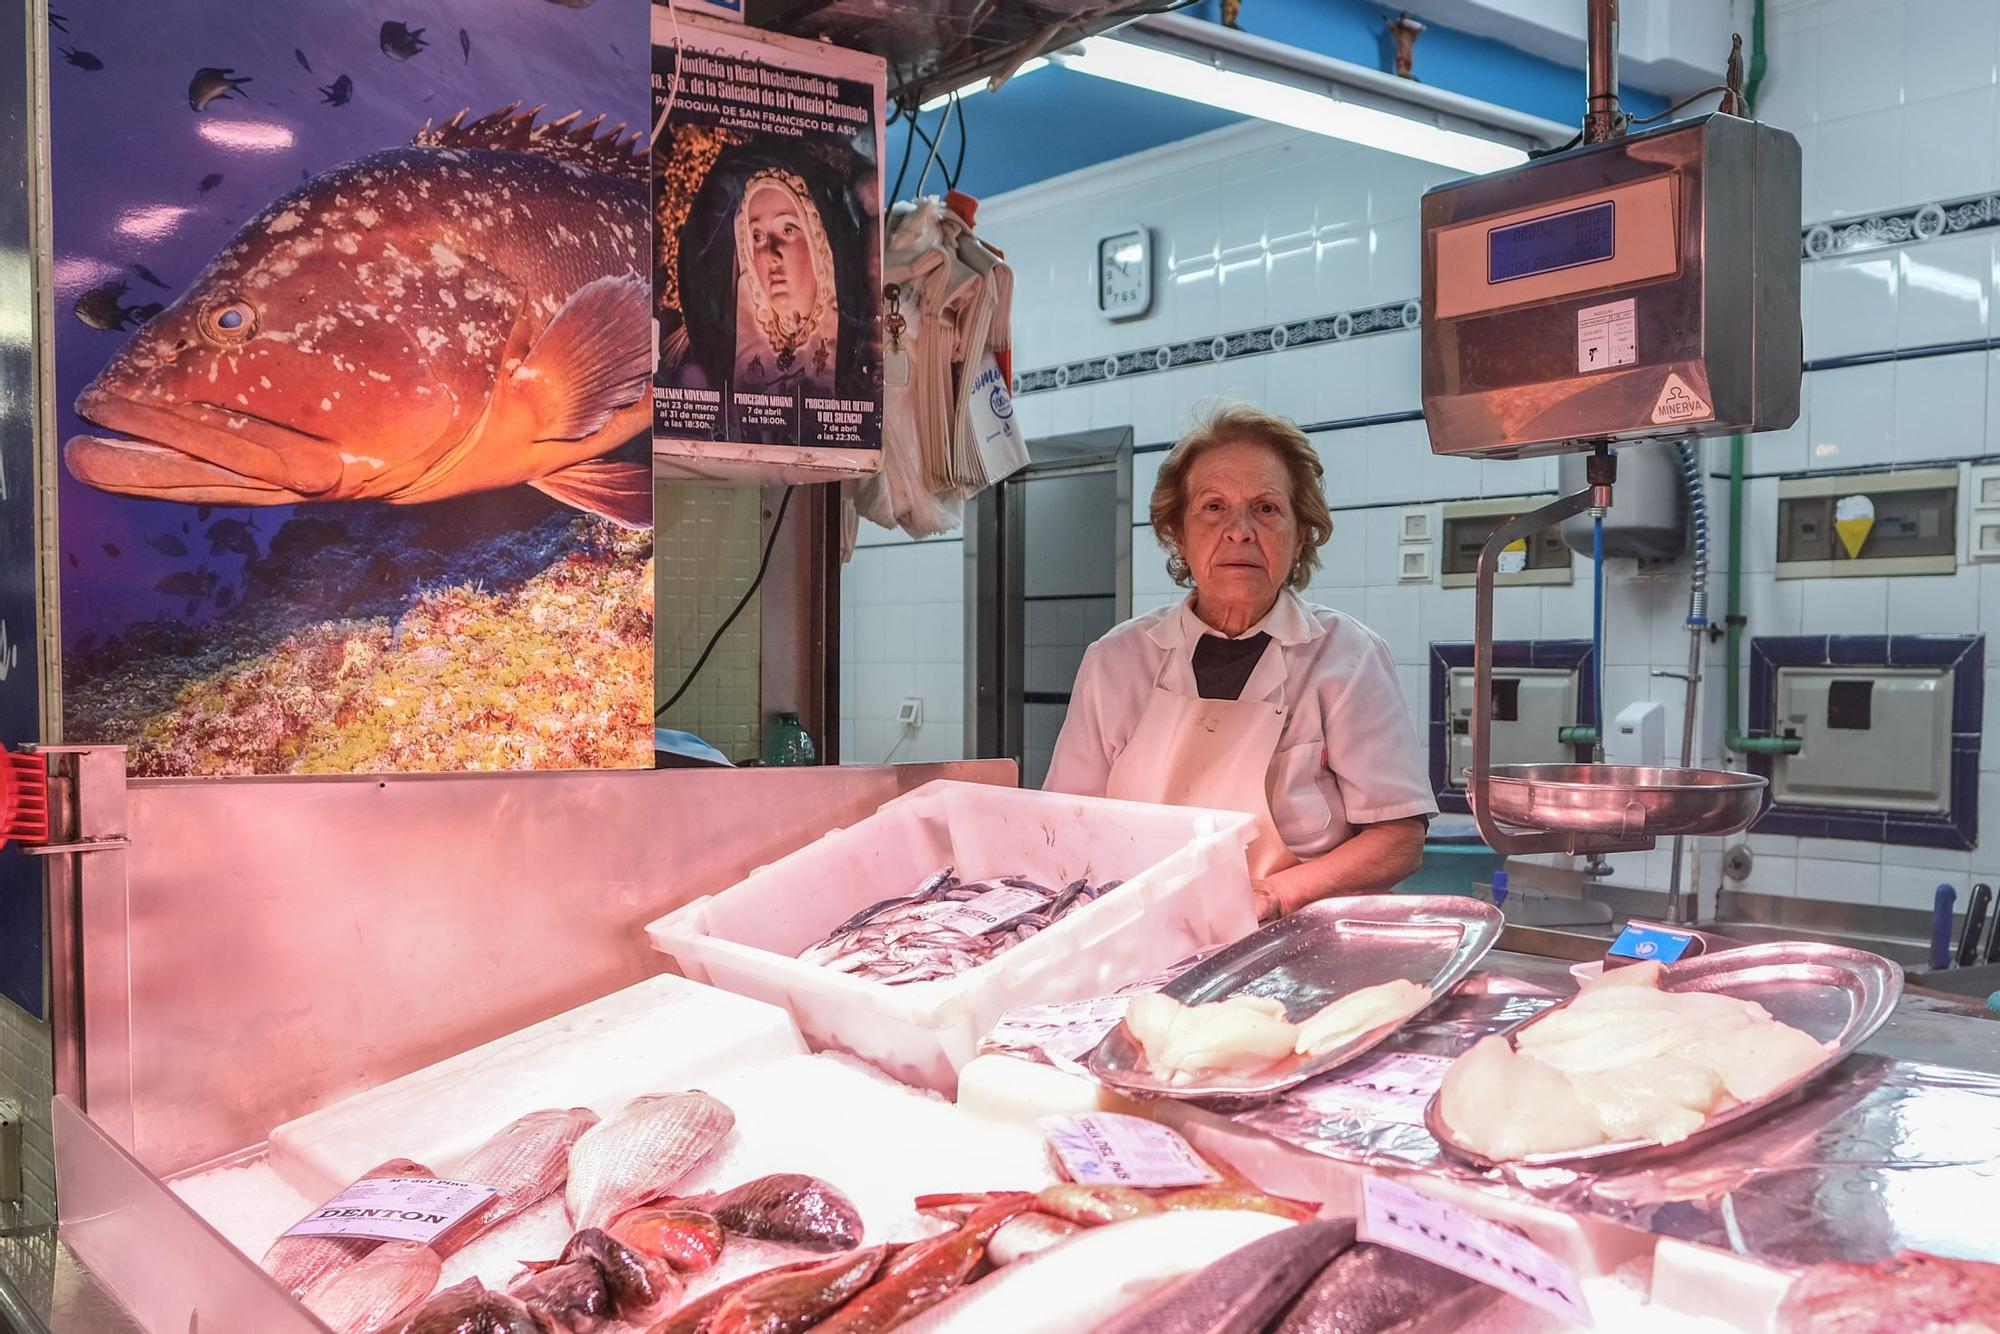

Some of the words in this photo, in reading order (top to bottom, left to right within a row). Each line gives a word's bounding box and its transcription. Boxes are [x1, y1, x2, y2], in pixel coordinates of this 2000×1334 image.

[727, 64, 733, 81] y
[735, 64, 758, 83] Real
[826, 81, 839, 97] de
[667, 73, 689, 93] Sa.
[691, 77, 705, 95] de
[706, 79, 717, 97] la
[718, 81, 760, 104] Soledad
[762, 89, 774, 106] de
[776, 90, 786, 108] la
[826, 99, 868, 123] Coronada
[722, 105, 737, 116] DE
[738, 107, 760, 120] SAN
[762, 112, 819, 129] FRANCISCO
[821, 121, 834, 132] DE
[719, 116, 760, 130] ALAMEDA
[761, 123, 773, 132] DE
[656, 400, 670, 408] Del
[671, 401, 681, 409] 23
[683, 402, 693, 410] de
[1658, 401, 1703, 416] MINERVA
[660, 410, 667, 418] al
[669, 410, 678, 418] 31
[680, 411, 690, 419] de
[692, 412, 716, 420] marzo
[747, 406, 752, 414] 7
[753, 407, 763, 415] de
[764, 407, 782, 416] abril
[671, 419, 682, 428] las
[748, 415, 758, 423] las
[822, 423, 828, 431] 7
[829, 424, 839, 432] de
[840, 424, 857, 433] abril
[823, 432, 834, 440] las
[315, 1208, 448, 1225] DENTON
